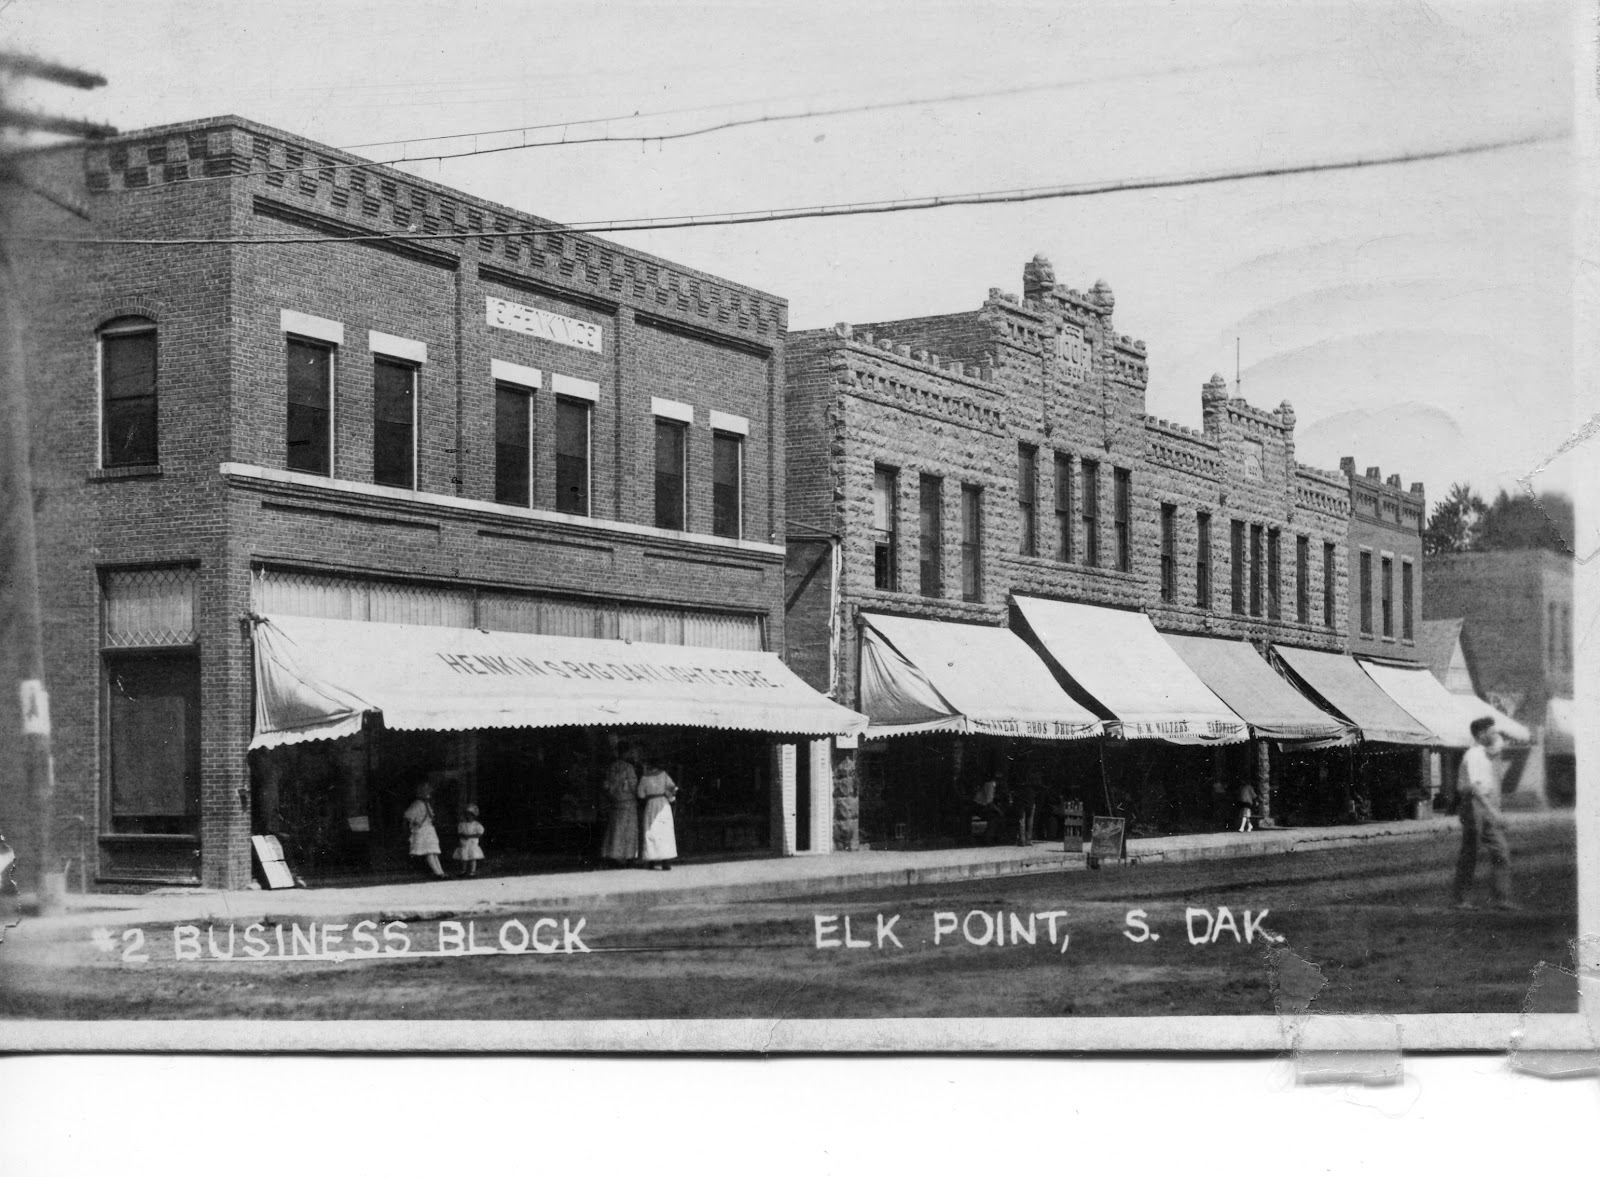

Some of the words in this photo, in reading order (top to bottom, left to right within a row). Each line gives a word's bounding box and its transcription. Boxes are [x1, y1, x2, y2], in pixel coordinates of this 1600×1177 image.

[561, 660, 615, 681] BIG
[606, 662, 719, 685] DAYLIGHT
[1026, 721, 1048, 735] BROS
